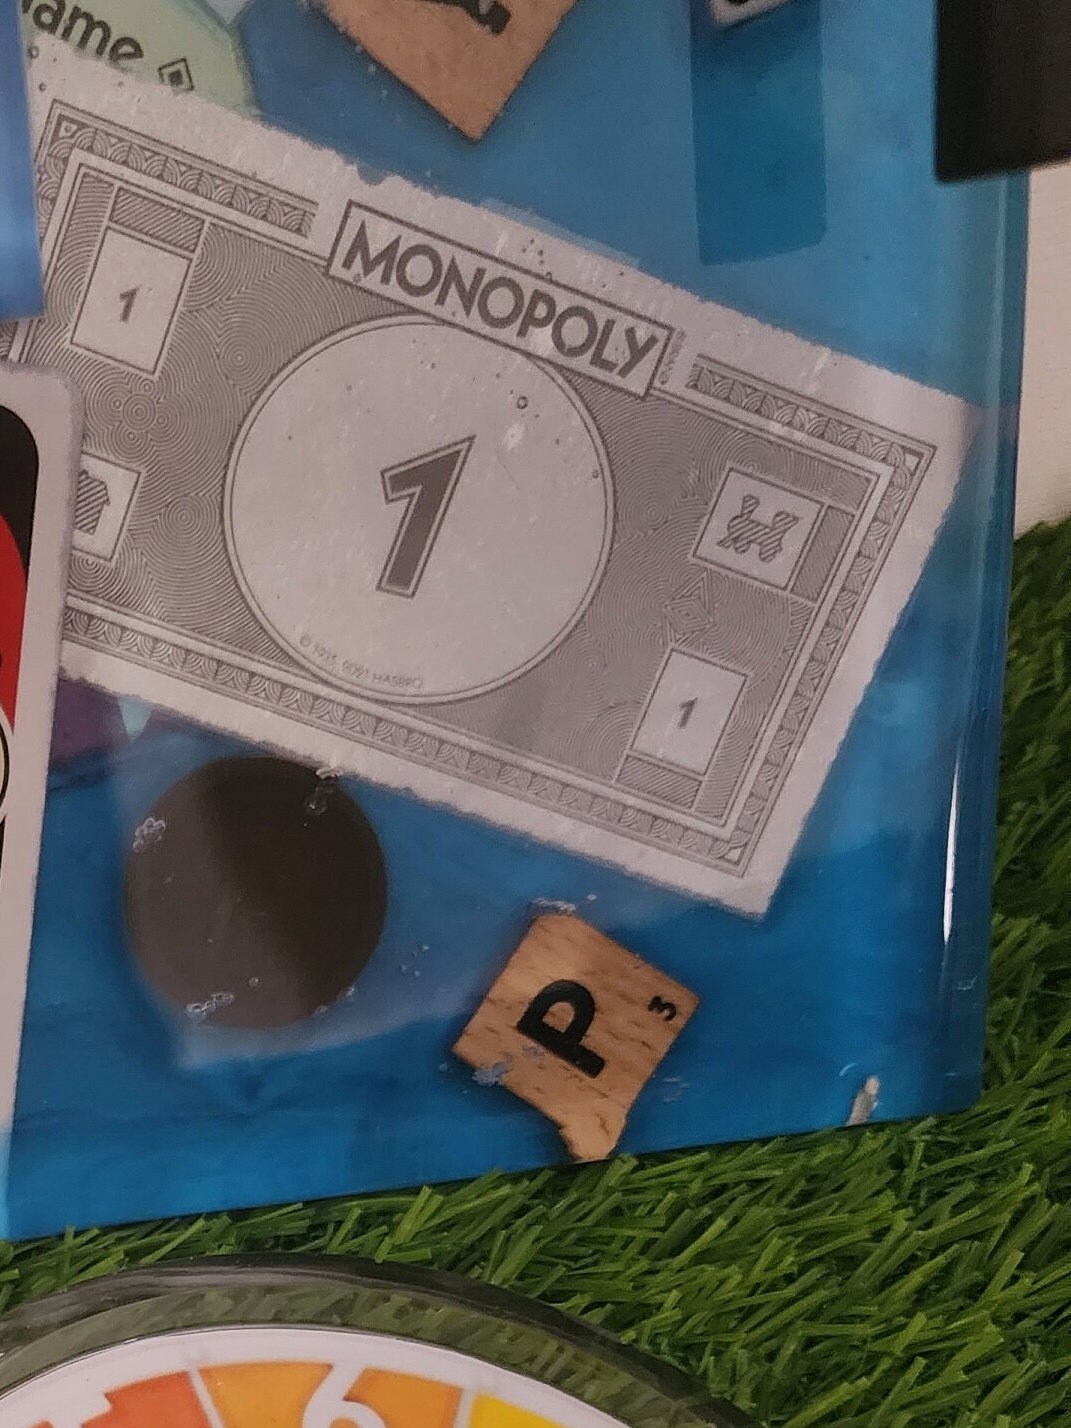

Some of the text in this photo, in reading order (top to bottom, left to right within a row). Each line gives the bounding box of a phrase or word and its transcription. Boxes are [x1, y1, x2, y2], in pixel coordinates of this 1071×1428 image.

[22, 0, 144, 63] ame
[119, 283, 143, 324] 1
[341, 219, 659, 379] MONOPOLY
[376, 433, 477, 598] 1
[677, 696, 698, 729] 1
[516, 978, 606, 1079] P
[647, 995, 677, 1023] 3
